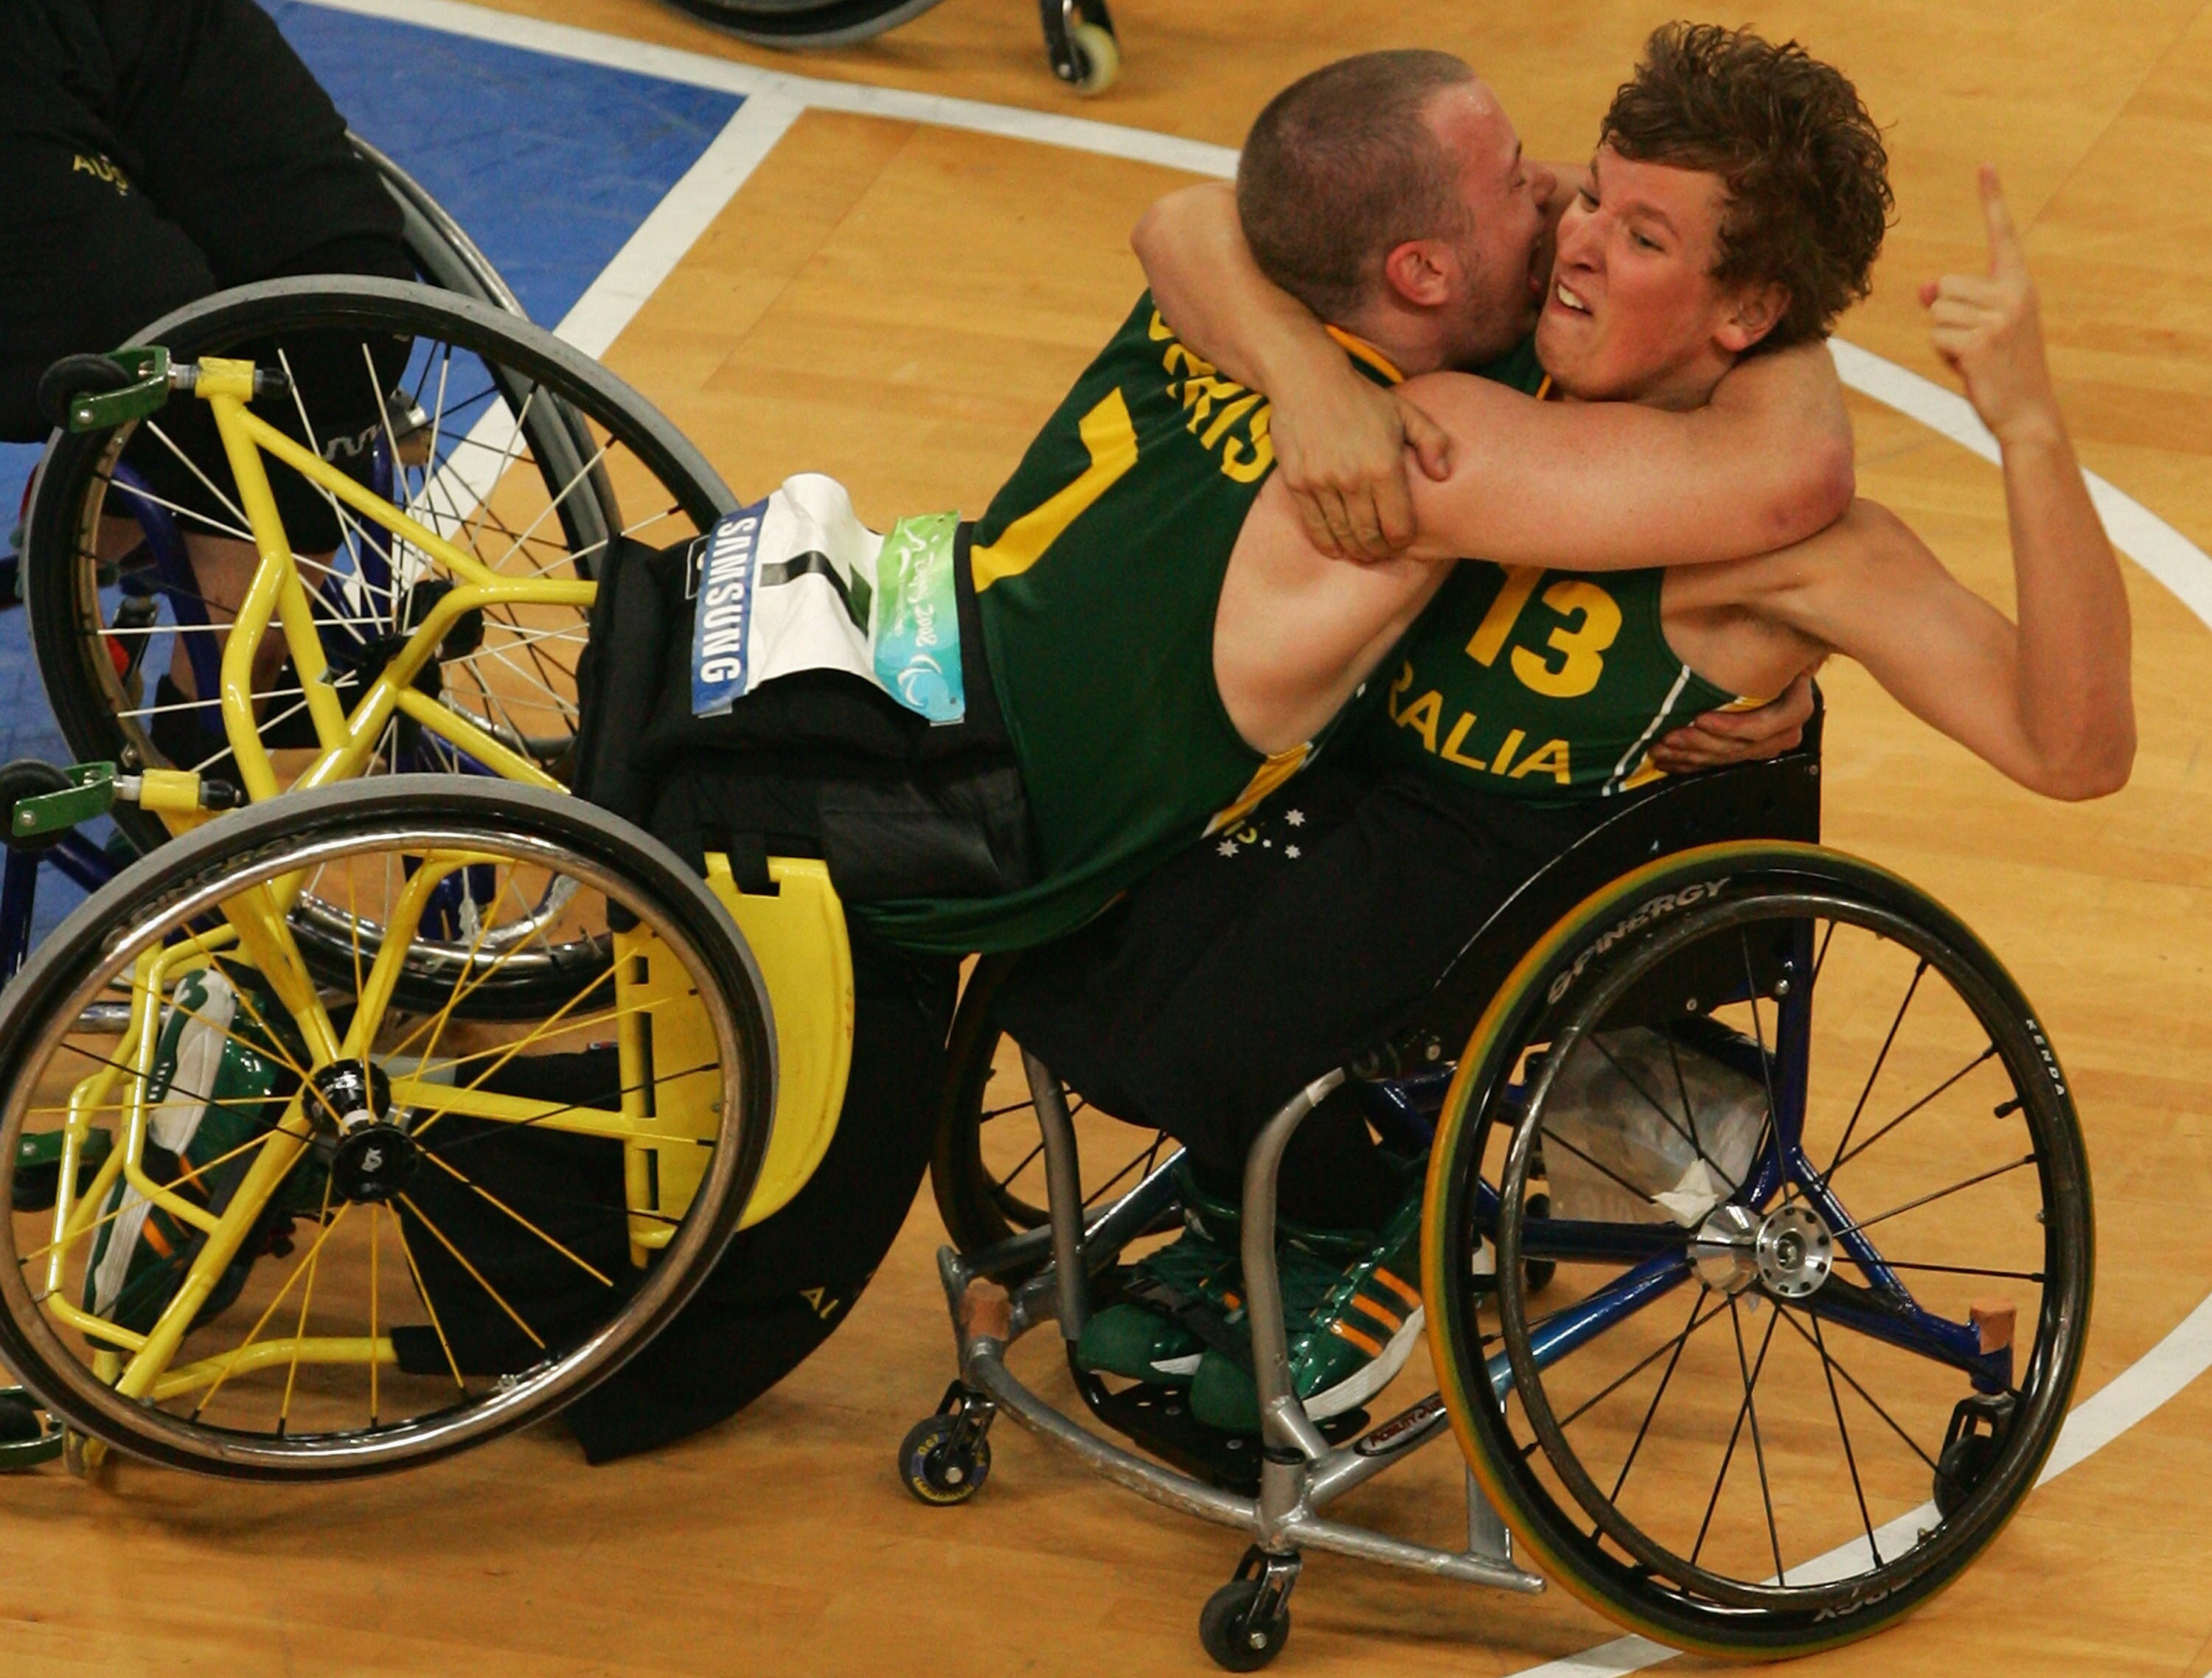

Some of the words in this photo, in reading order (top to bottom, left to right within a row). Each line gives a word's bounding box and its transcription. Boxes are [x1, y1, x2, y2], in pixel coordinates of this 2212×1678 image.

[700, 517, 757, 684] SAMSUNG
[915, 603, 937, 647] 2008
[1465, 562, 1622, 697] 13
[2025, 1019, 2065, 1096] KENDA
